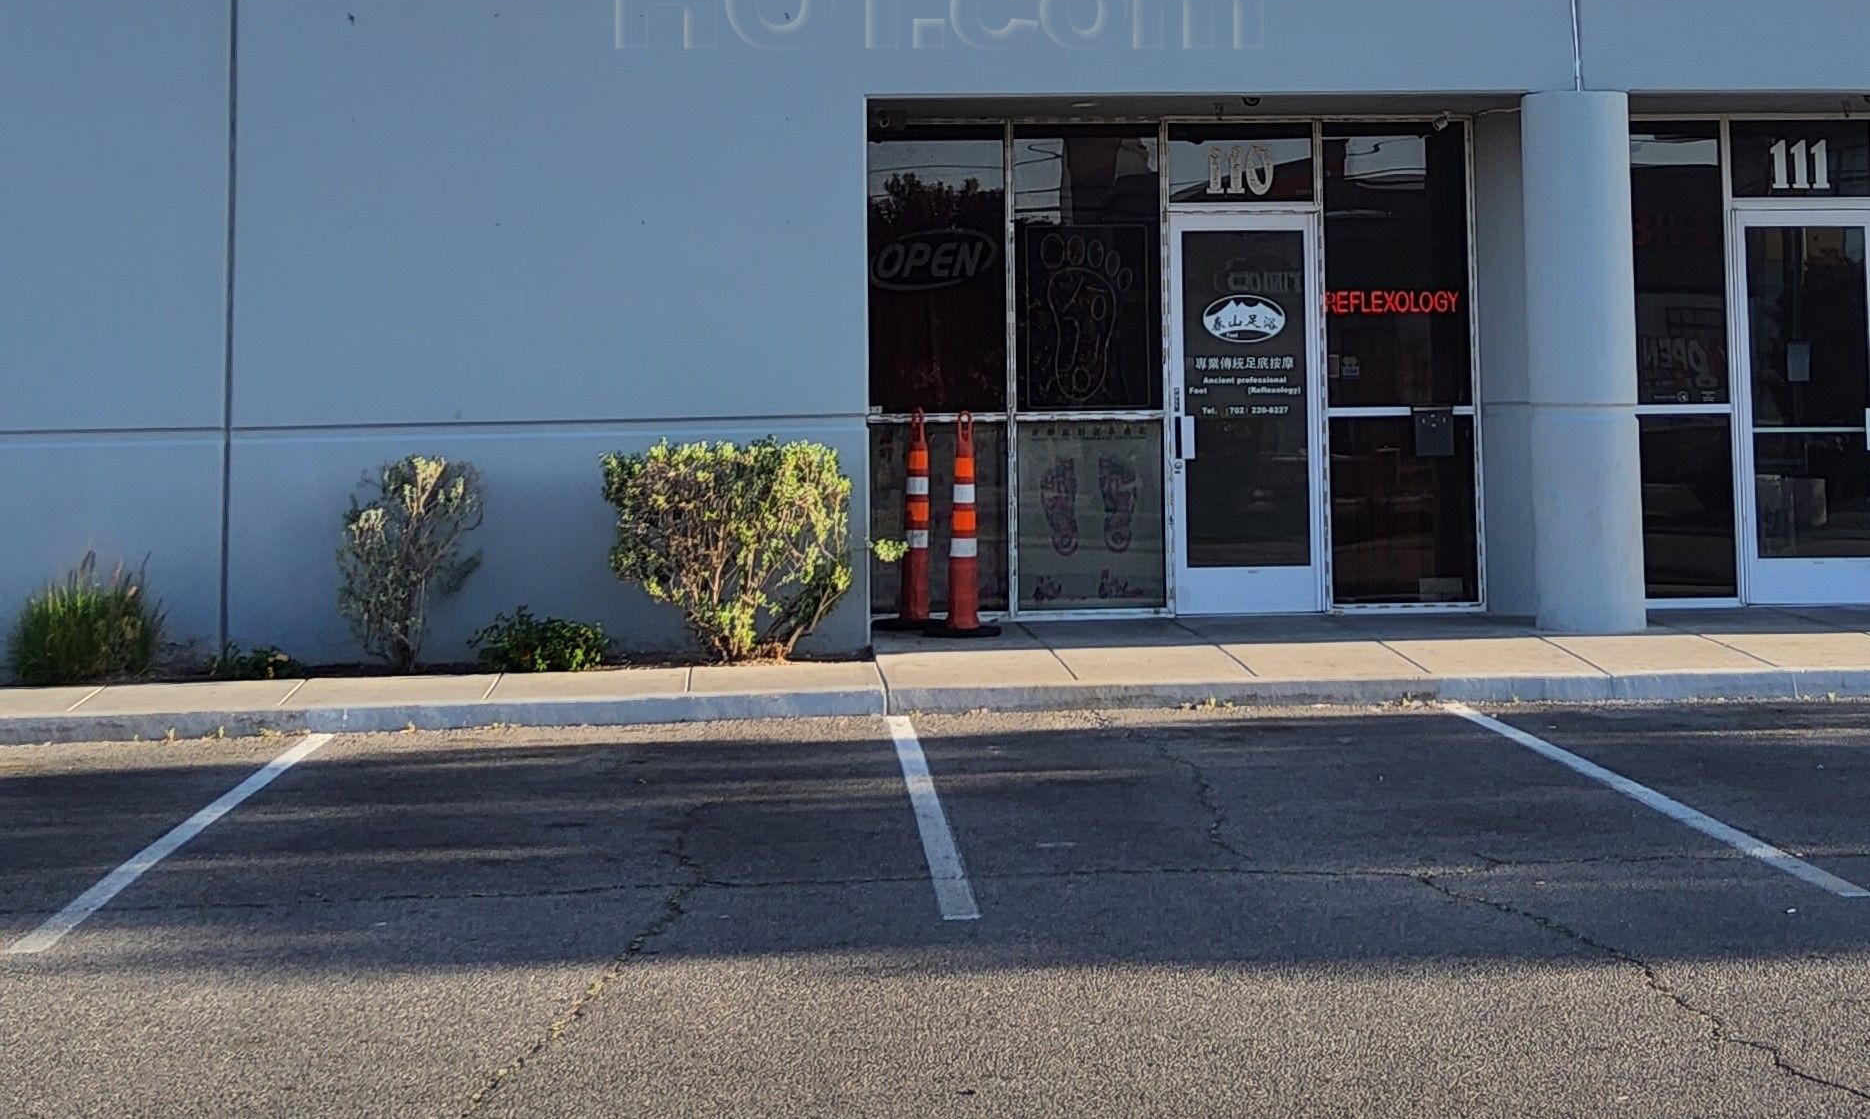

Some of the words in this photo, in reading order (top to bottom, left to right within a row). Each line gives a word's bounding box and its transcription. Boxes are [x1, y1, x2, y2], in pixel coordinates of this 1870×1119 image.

[1206, 145, 1275, 196] 110
[1770, 139, 1831, 190] 111
[876, 240, 984, 279] OPEN
[1325, 289, 1460, 314] REFLEXOLOGY
[1188, 386, 1208, 395] Foot
[1202, 376, 1235, 385] Ancient
[1237, 375, 1288, 386] professional
